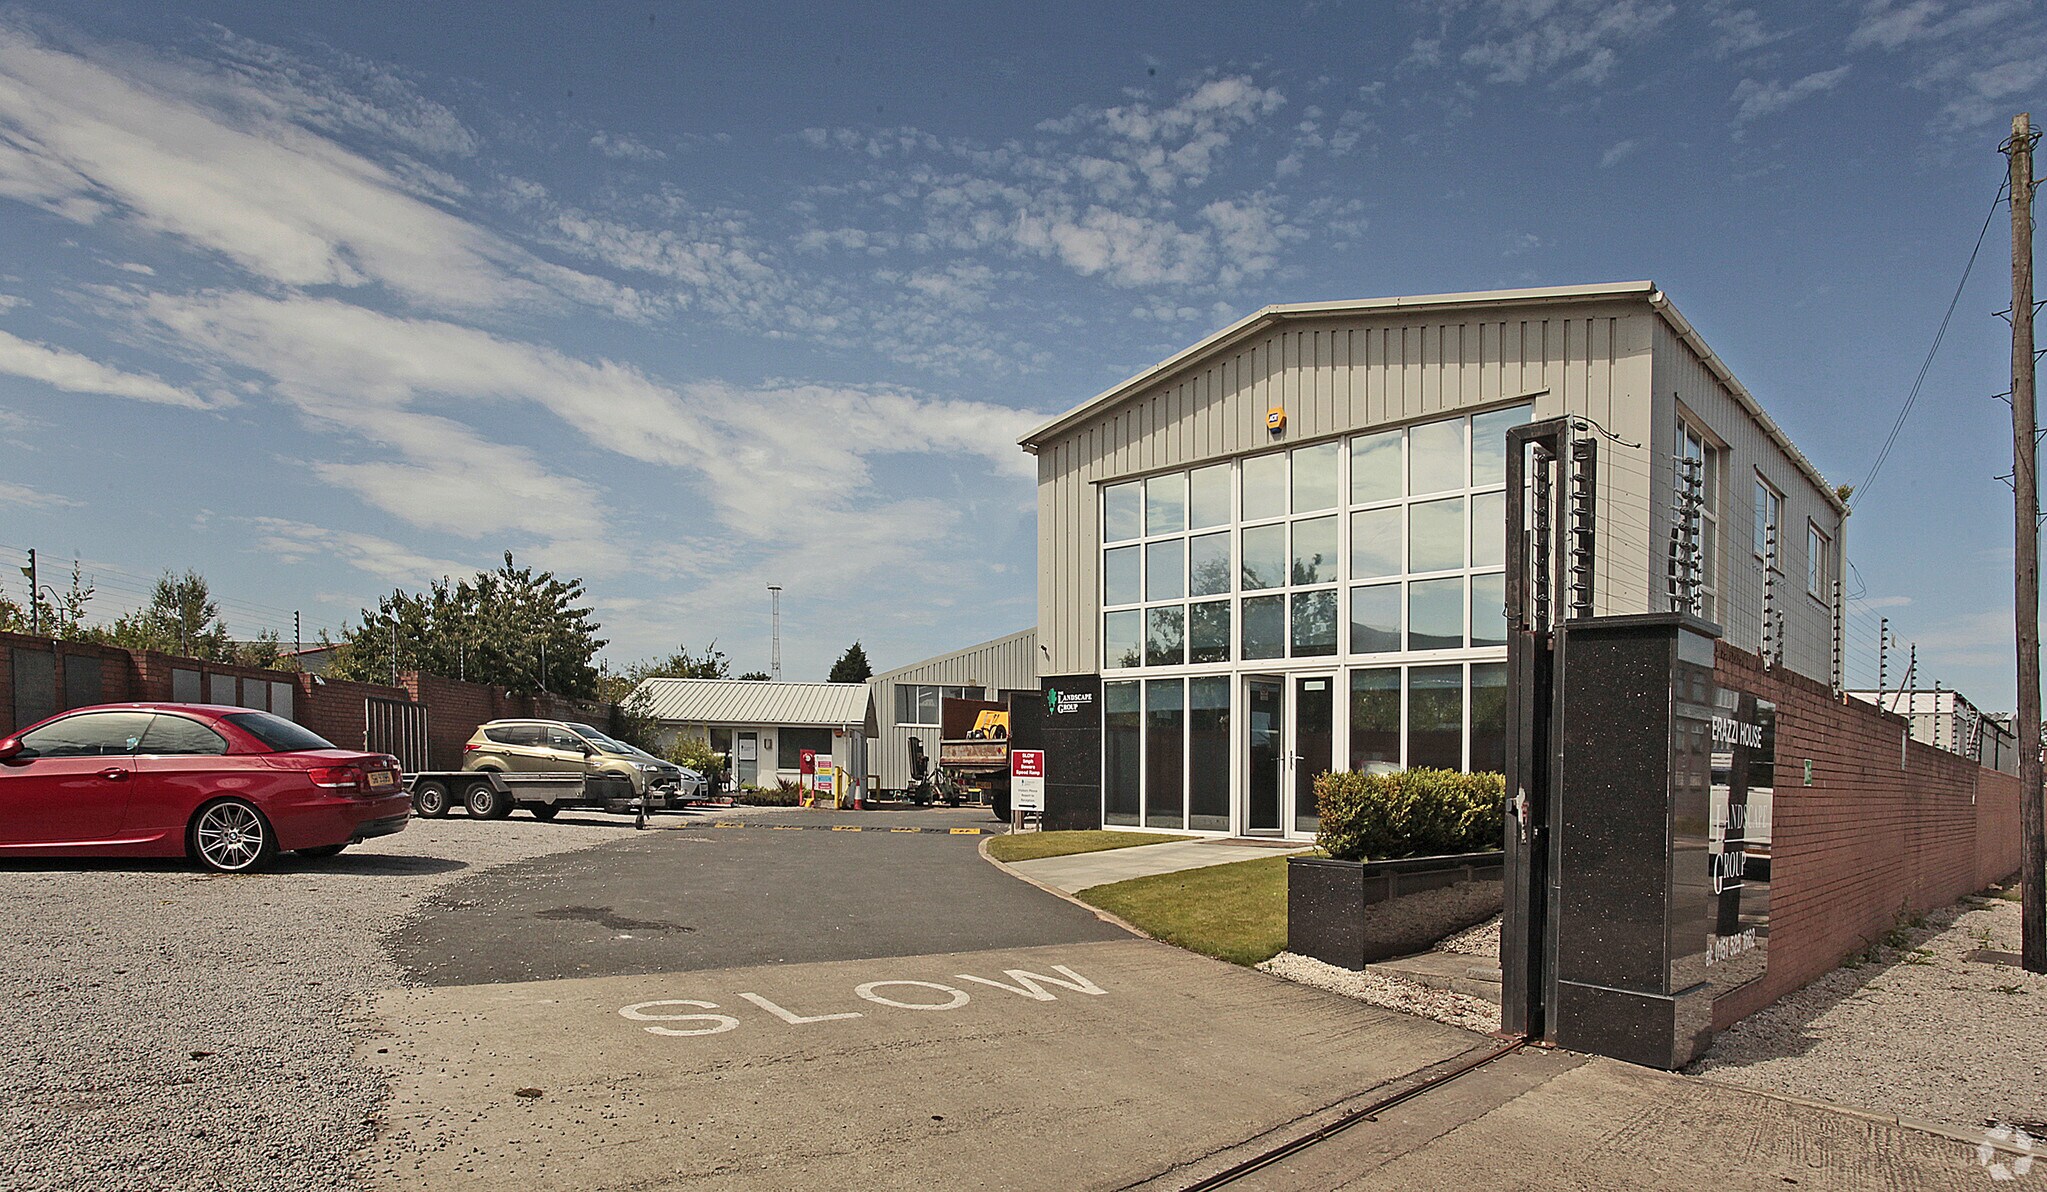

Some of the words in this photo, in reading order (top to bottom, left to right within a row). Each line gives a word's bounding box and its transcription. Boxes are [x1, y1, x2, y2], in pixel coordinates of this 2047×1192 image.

[1057, 704, 1078, 714] GROUP
[1058, 693, 1092, 704] LANDSCAPE
[1712, 715, 1738, 744] ERAZZI
[1740, 722, 1762, 749] HOUSE
[1716, 804, 1768, 844] LANDSCAPE
[1713, 850, 1747, 895] GROUP
[618, 964, 1109, 1037] SLOW
